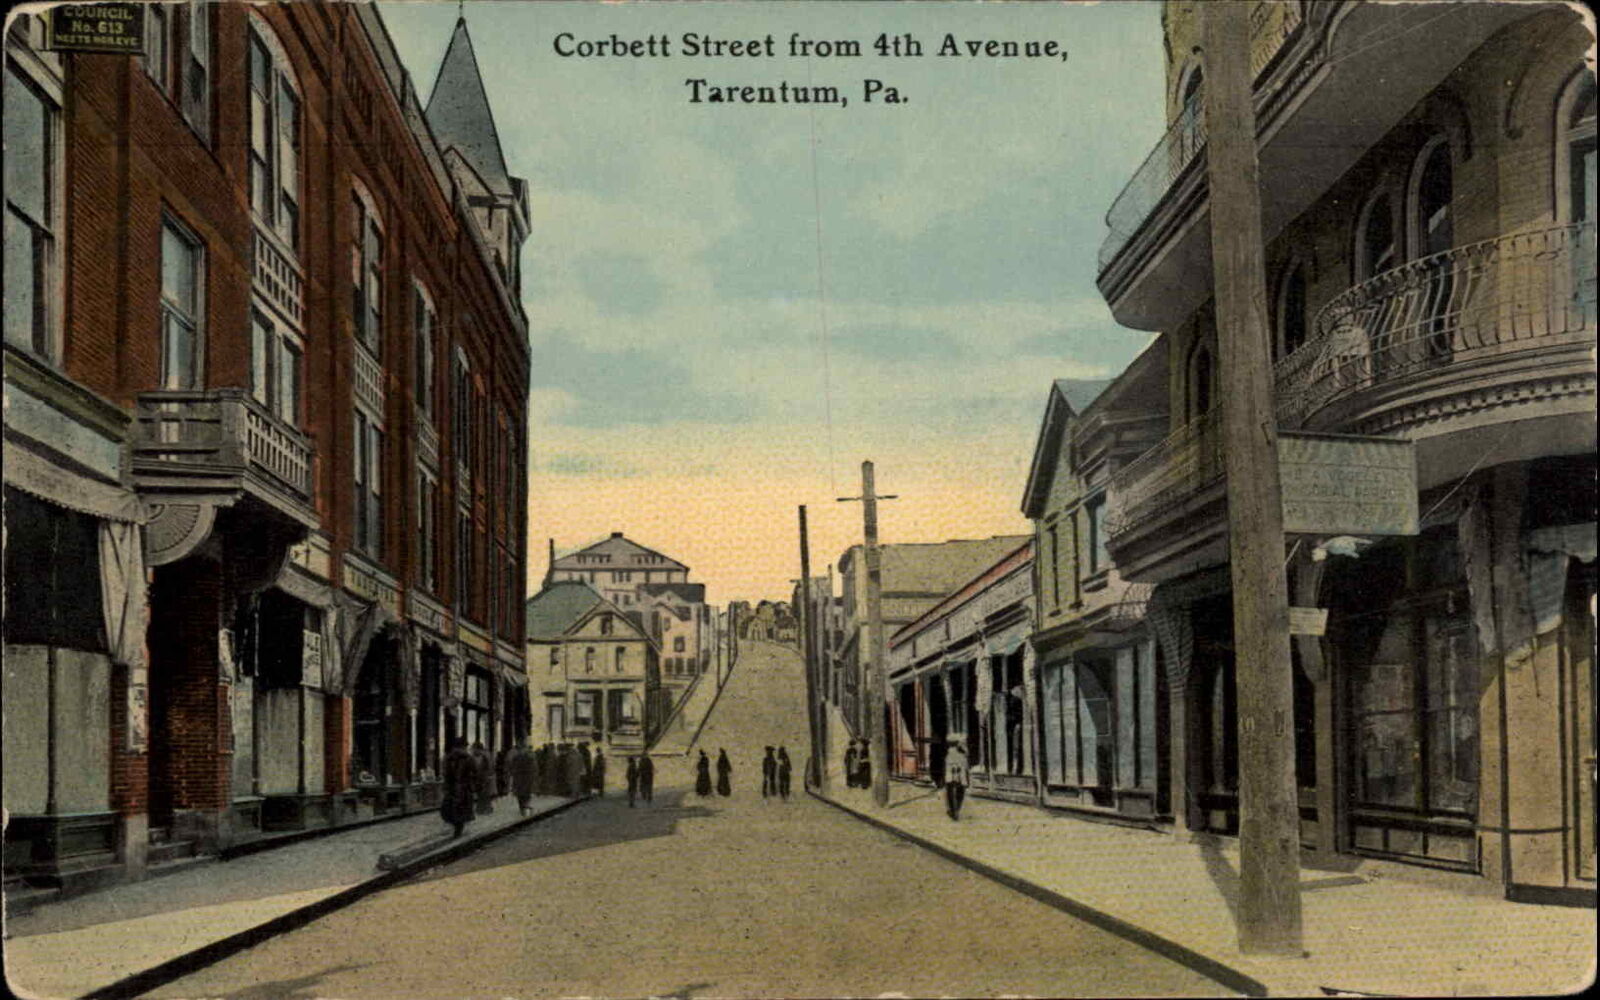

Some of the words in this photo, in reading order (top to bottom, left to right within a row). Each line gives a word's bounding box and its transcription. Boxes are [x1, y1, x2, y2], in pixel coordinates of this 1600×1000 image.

[64, 6, 133, 20] COUNCIL
[72, 20, 95, 33] No.
[98, 21, 124, 34] 613
